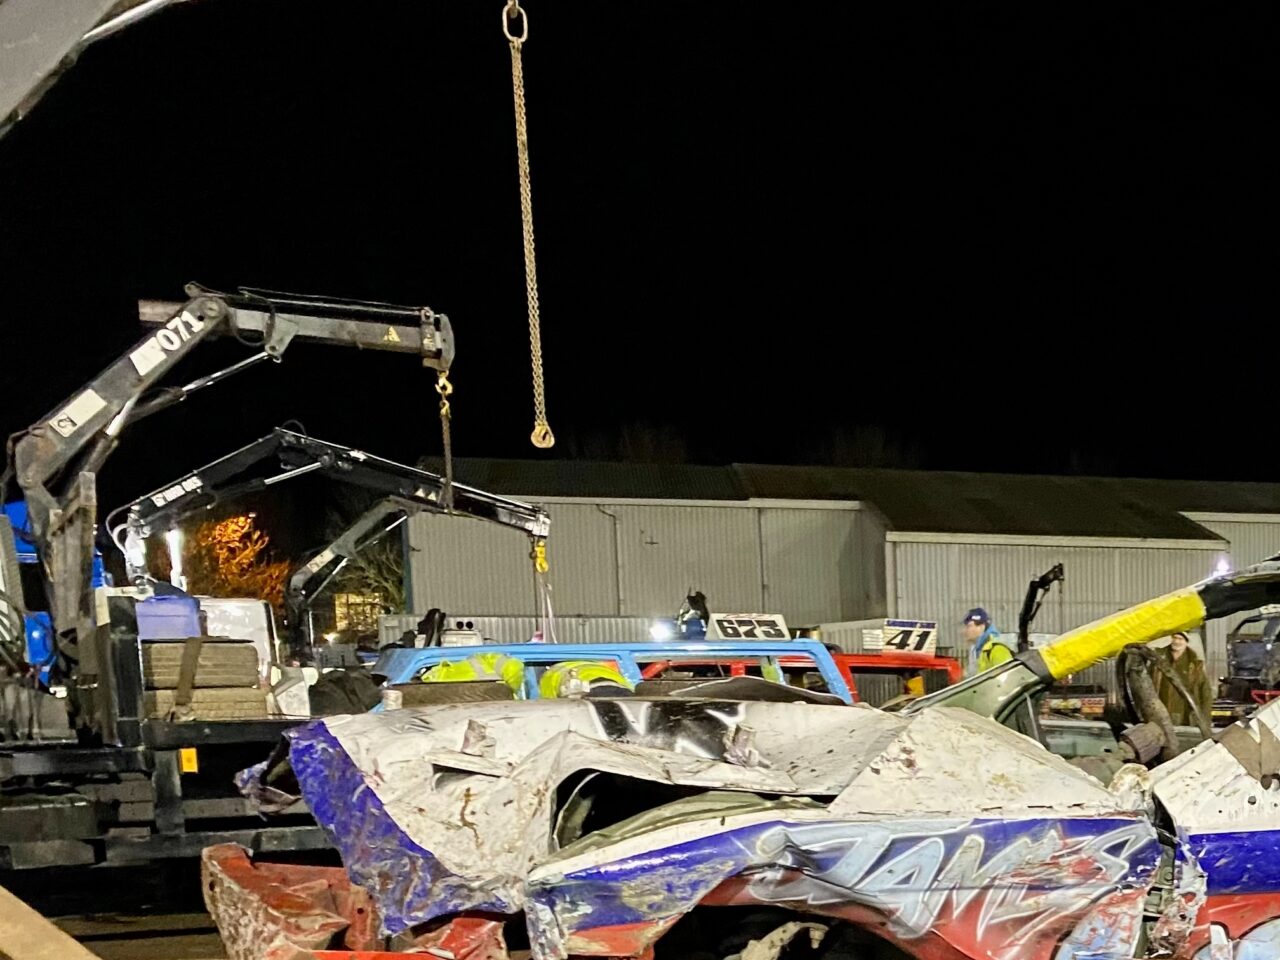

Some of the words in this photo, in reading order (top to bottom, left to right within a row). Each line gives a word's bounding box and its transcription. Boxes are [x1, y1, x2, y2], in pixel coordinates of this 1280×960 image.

[156, 310, 205, 351] 071
[715, 619, 786, 639] 673
[886, 629, 932, 651] 41
